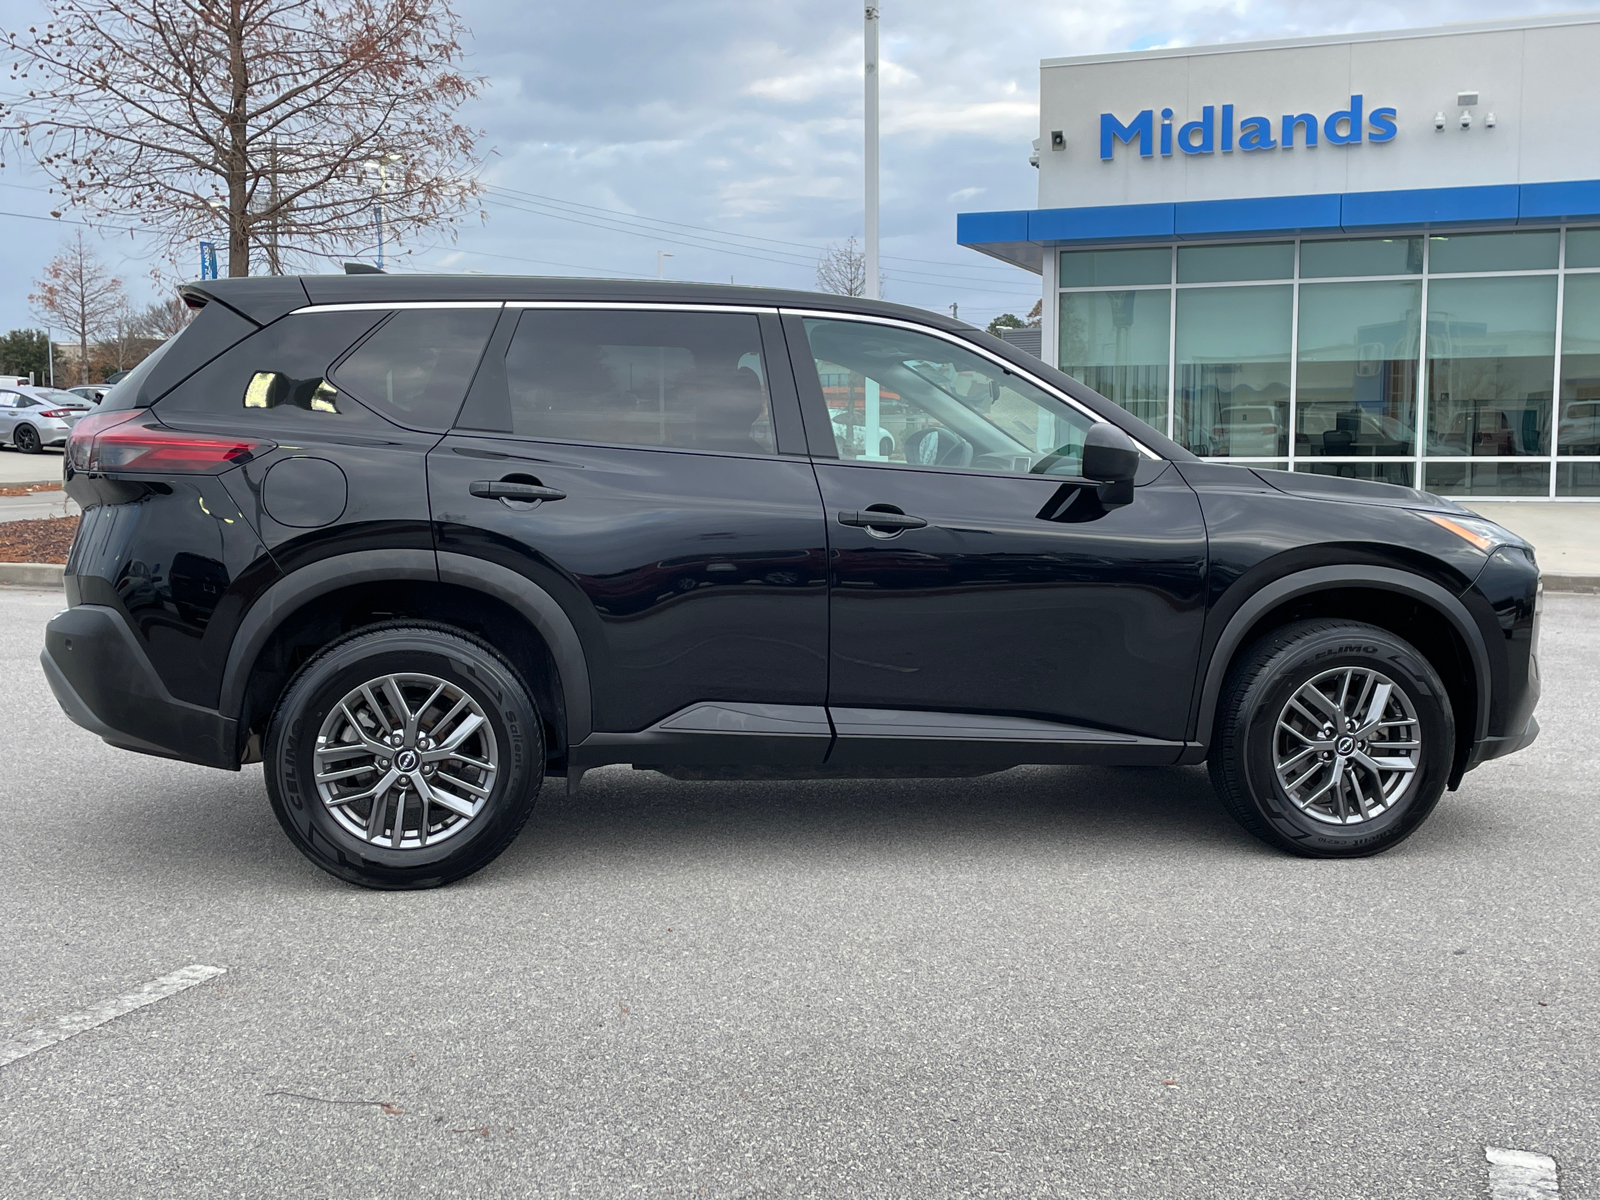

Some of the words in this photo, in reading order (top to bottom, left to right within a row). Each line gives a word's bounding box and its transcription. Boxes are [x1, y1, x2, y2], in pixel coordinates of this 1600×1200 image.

[1100, 94, 1397, 159] Midlands
[284, 717, 304, 811] CELIMO
[505, 710, 523, 770] Salient
